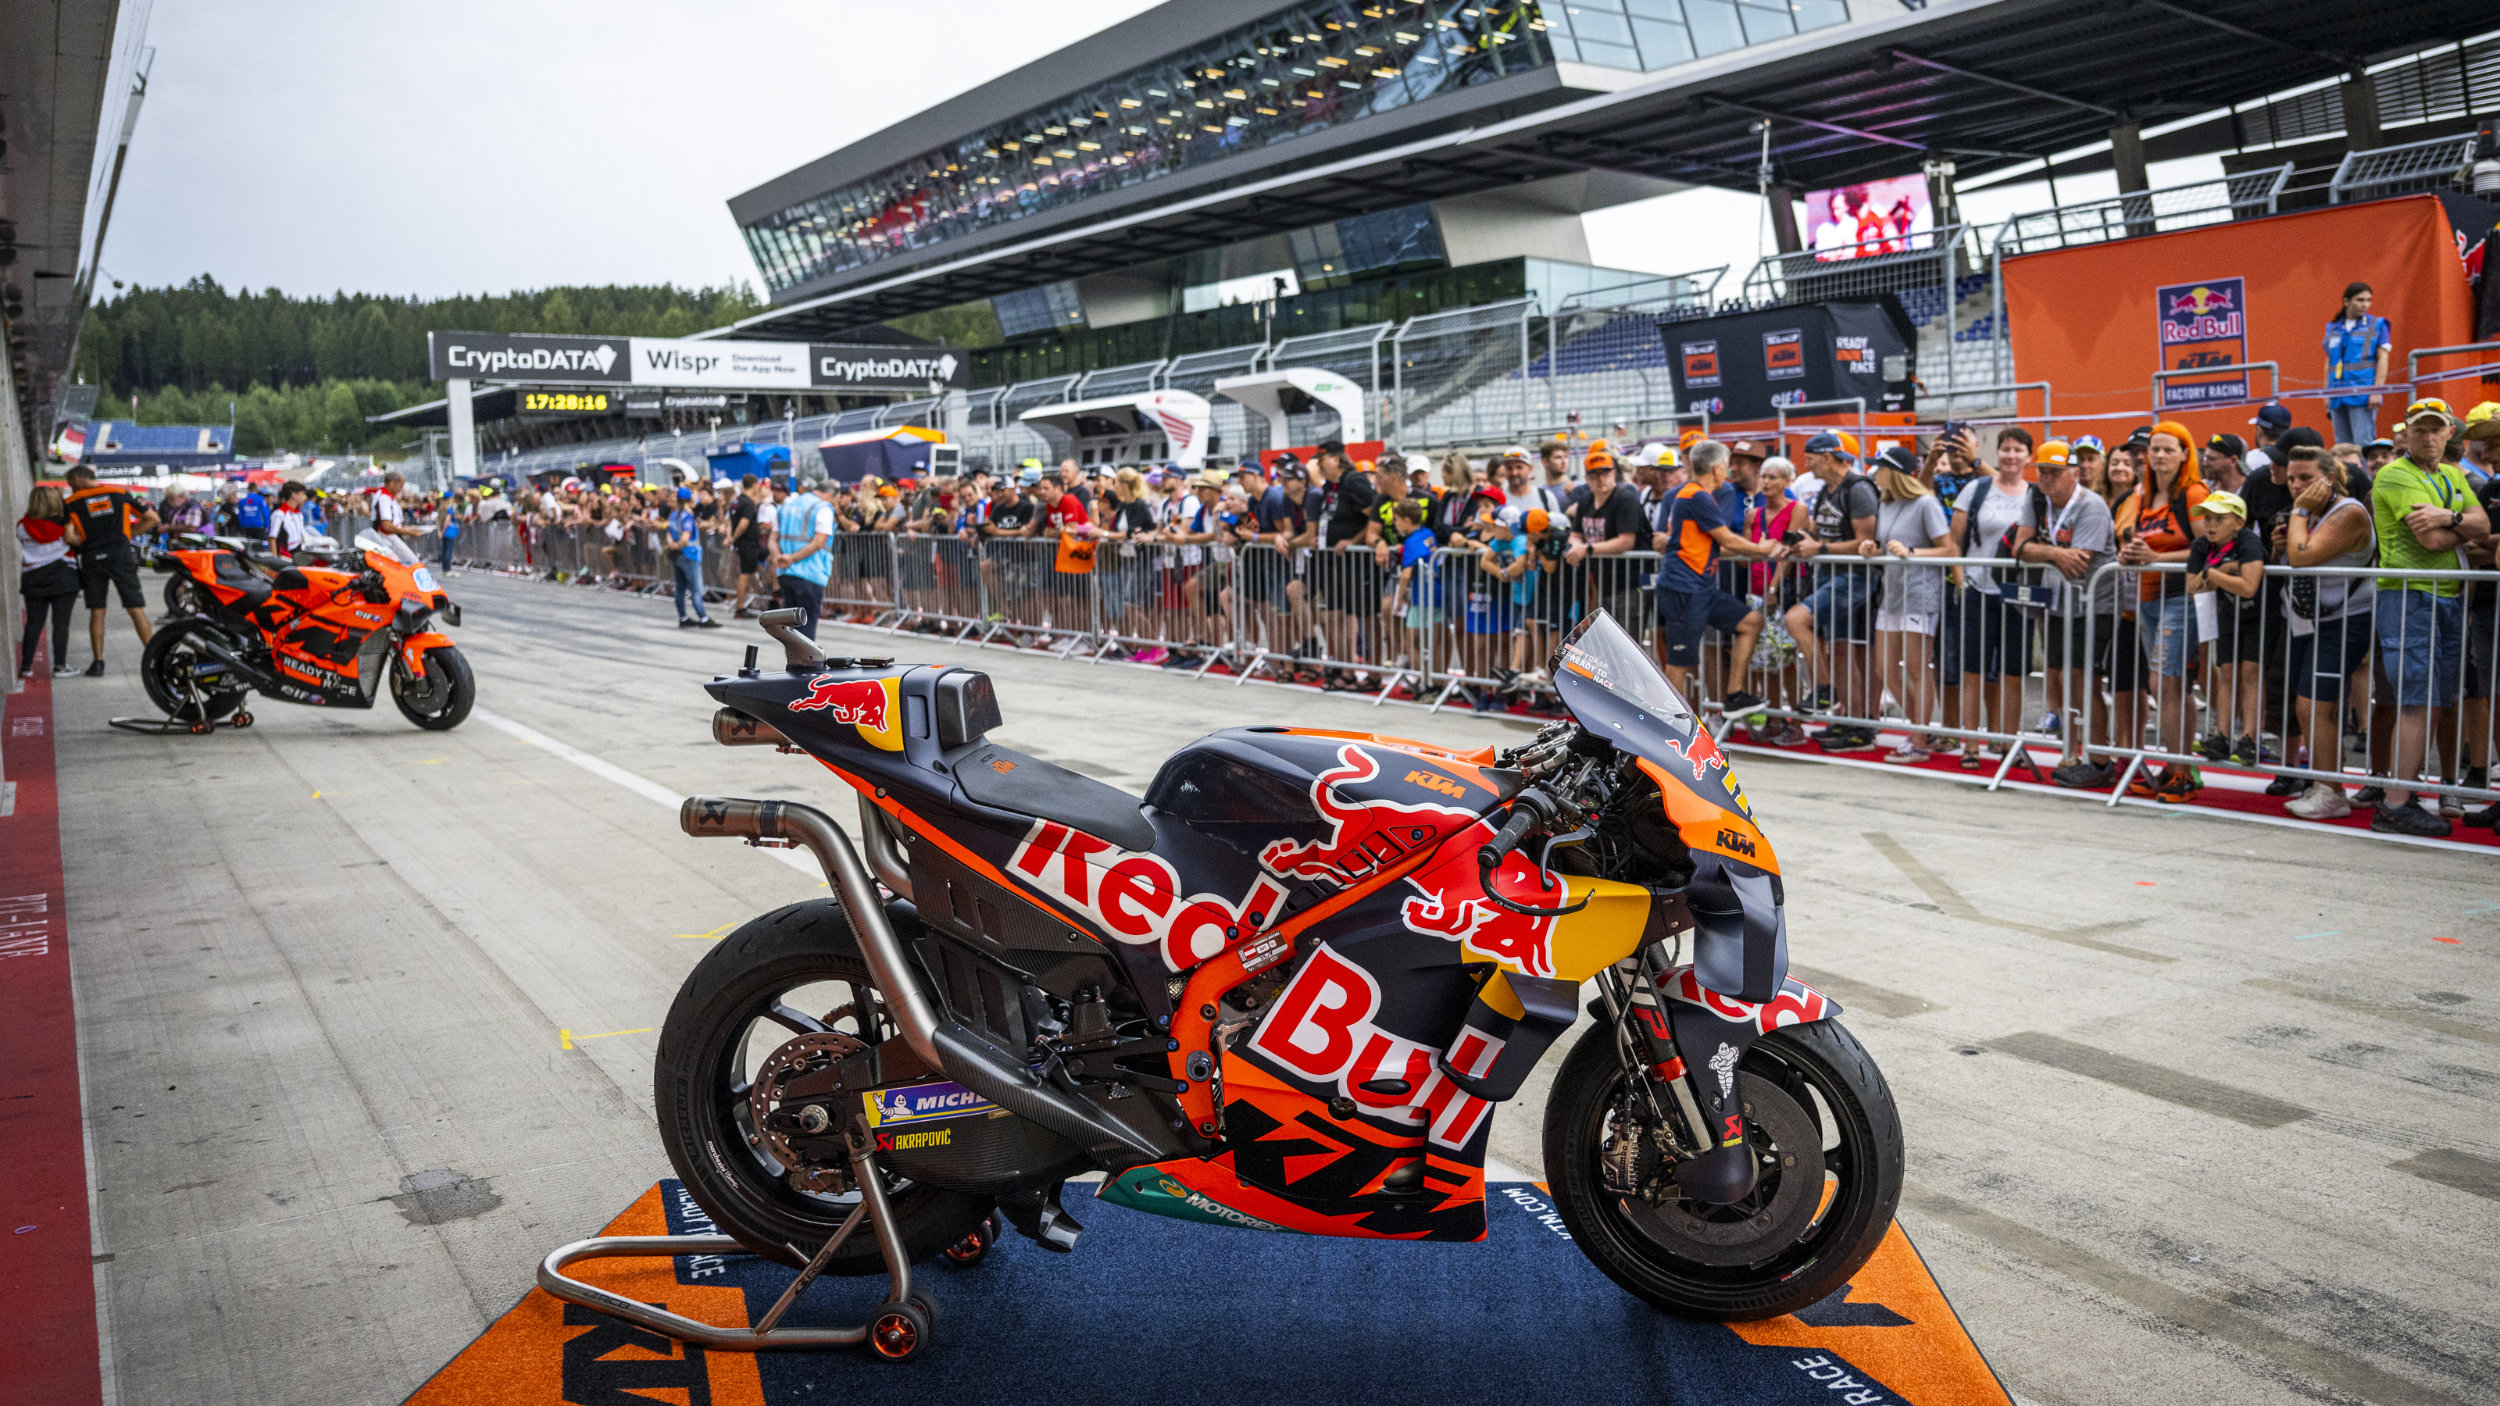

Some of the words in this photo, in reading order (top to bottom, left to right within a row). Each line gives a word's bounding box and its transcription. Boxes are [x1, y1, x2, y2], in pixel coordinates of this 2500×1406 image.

[2162, 316, 2200, 342] Red
[2201, 311, 2241, 338] Bull
[1836, 336, 1868, 350] READY
[448, 345, 601, 373] CryptoDATA
[647, 350, 720, 375] Wispr
[820, 356, 945, 382] CryptoDATA
[732, 354, 783, 363] Download
[1861, 349, 1875, 361] TO
[2177, 351, 2232, 370] KTM
[1850, 361, 1876, 373] RACE
[526, 394, 608, 411] 17:28:16
[2166, 387, 2206, 401] FACTORY
[2208, 384, 2245, 398] RACING
[355, 609, 374, 621] elf
[283, 655, 323, 679] READY
[1569, 655, 1597, 673] READY
[1597, 667, 1608, 678] TO
[1592, 674, 1615, 690] RACE
[1403, 769, 1466, 800] KTM
[1716, 828, 1756, 858] KTM
[1005, 817, 1290, 973] Red
[1247, 941, 1504, 1151] Bull
[896, 1128, 951, 1150] AKRAPOVIČ
[1185, 1192, 1283, 1231] MOTOREX
[689, 1254, 726, 1281] ACE
[1792, 1353, 1877, 1406] RACE
